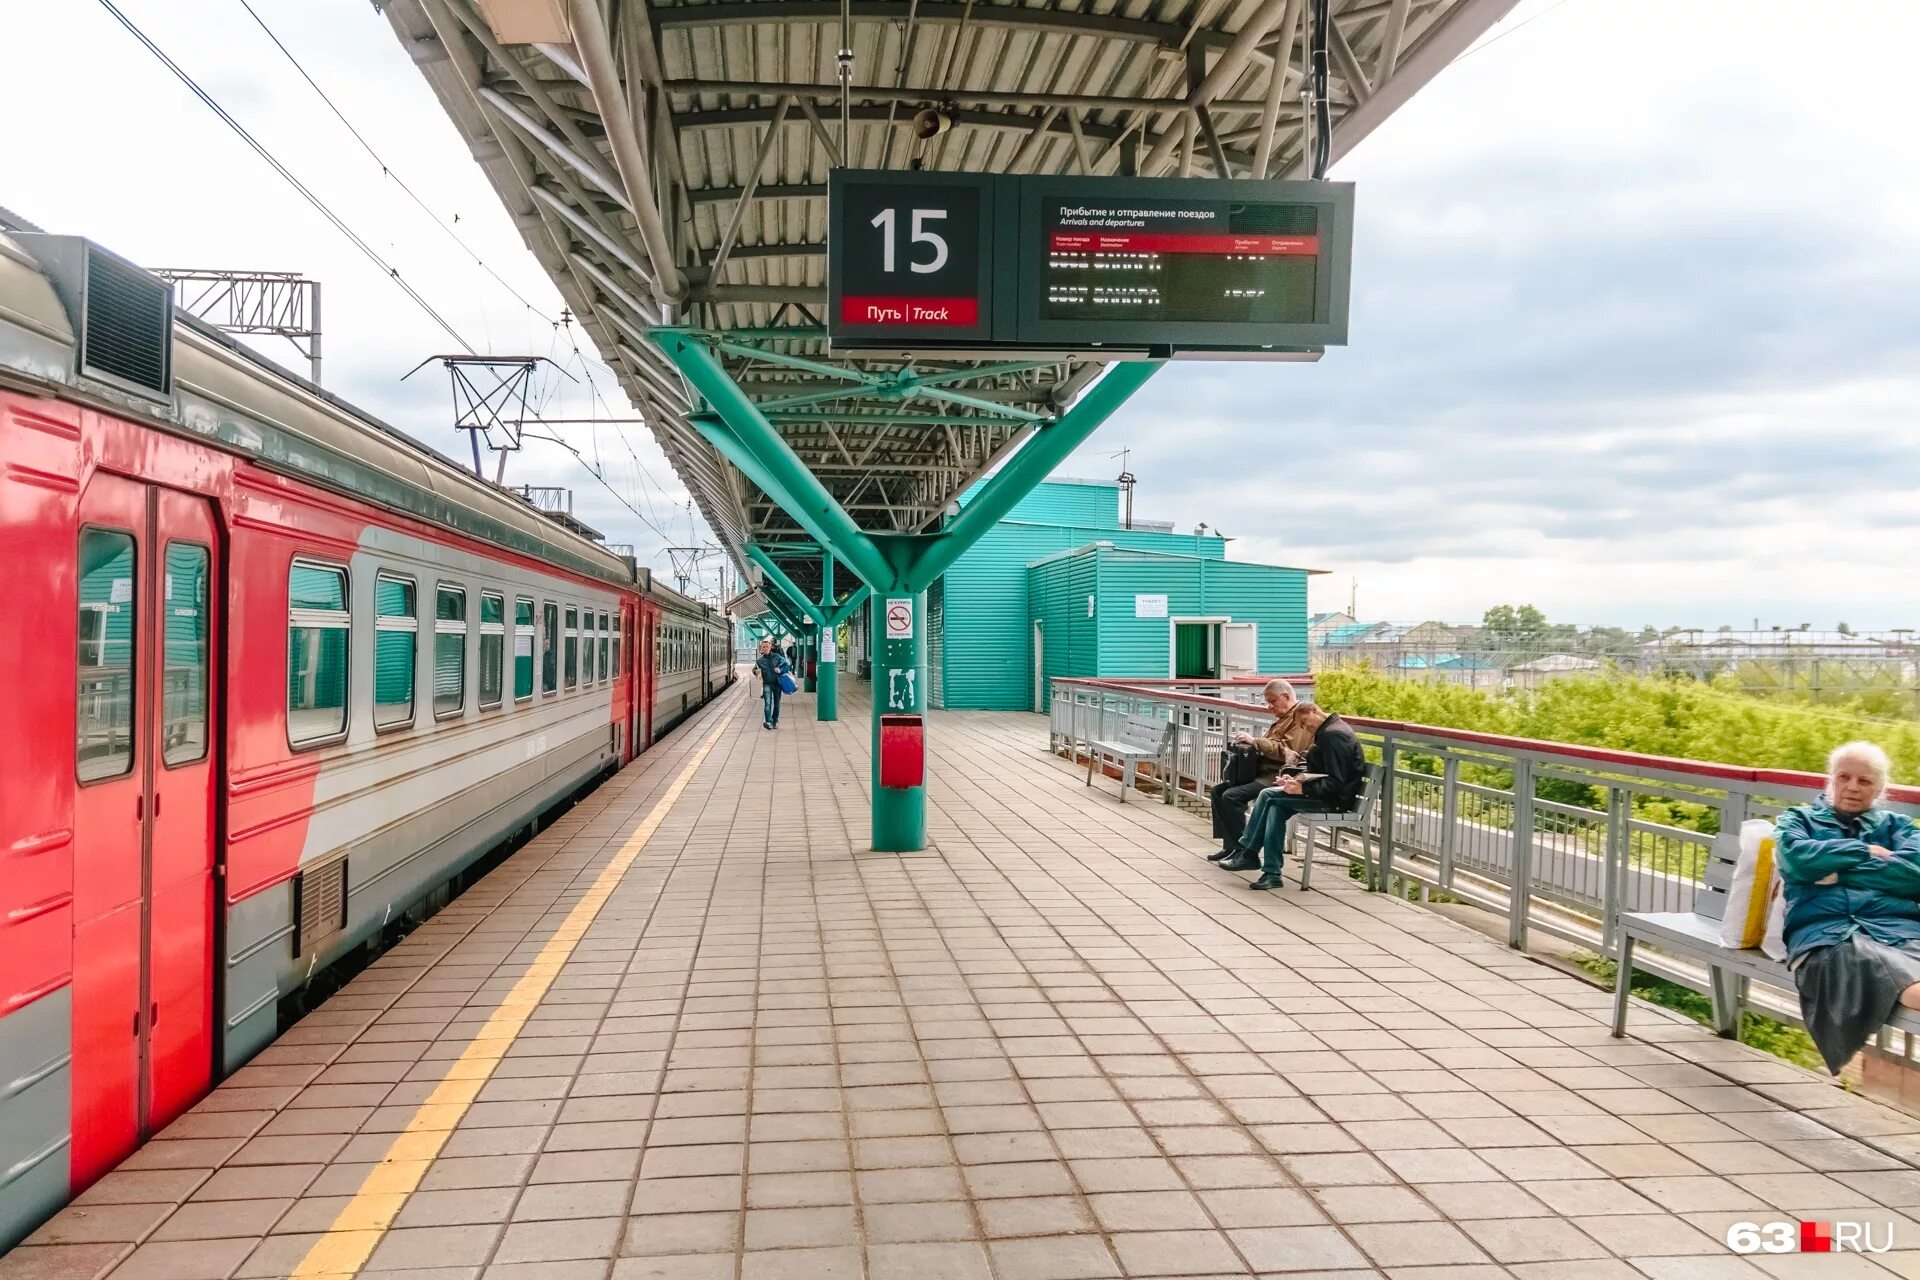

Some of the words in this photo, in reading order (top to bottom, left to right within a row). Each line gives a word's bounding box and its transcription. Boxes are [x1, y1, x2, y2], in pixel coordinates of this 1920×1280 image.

[1060, 206, 1107, 218] Прибытие
[1109, 209, 1115, 217] и
[1117, 209, 1176, 219] отправление
[1178, 210, 1215, 219] поездов
[1060, 218, 1088, 226] Arrivals
[1089, 218, 1104, 226] and
[1105, 219, 1145, 228] departures
[871, 208, 949, 274] 15
[867, 306, 902, 322] Путь
[913, 307, 949, 320] Track
